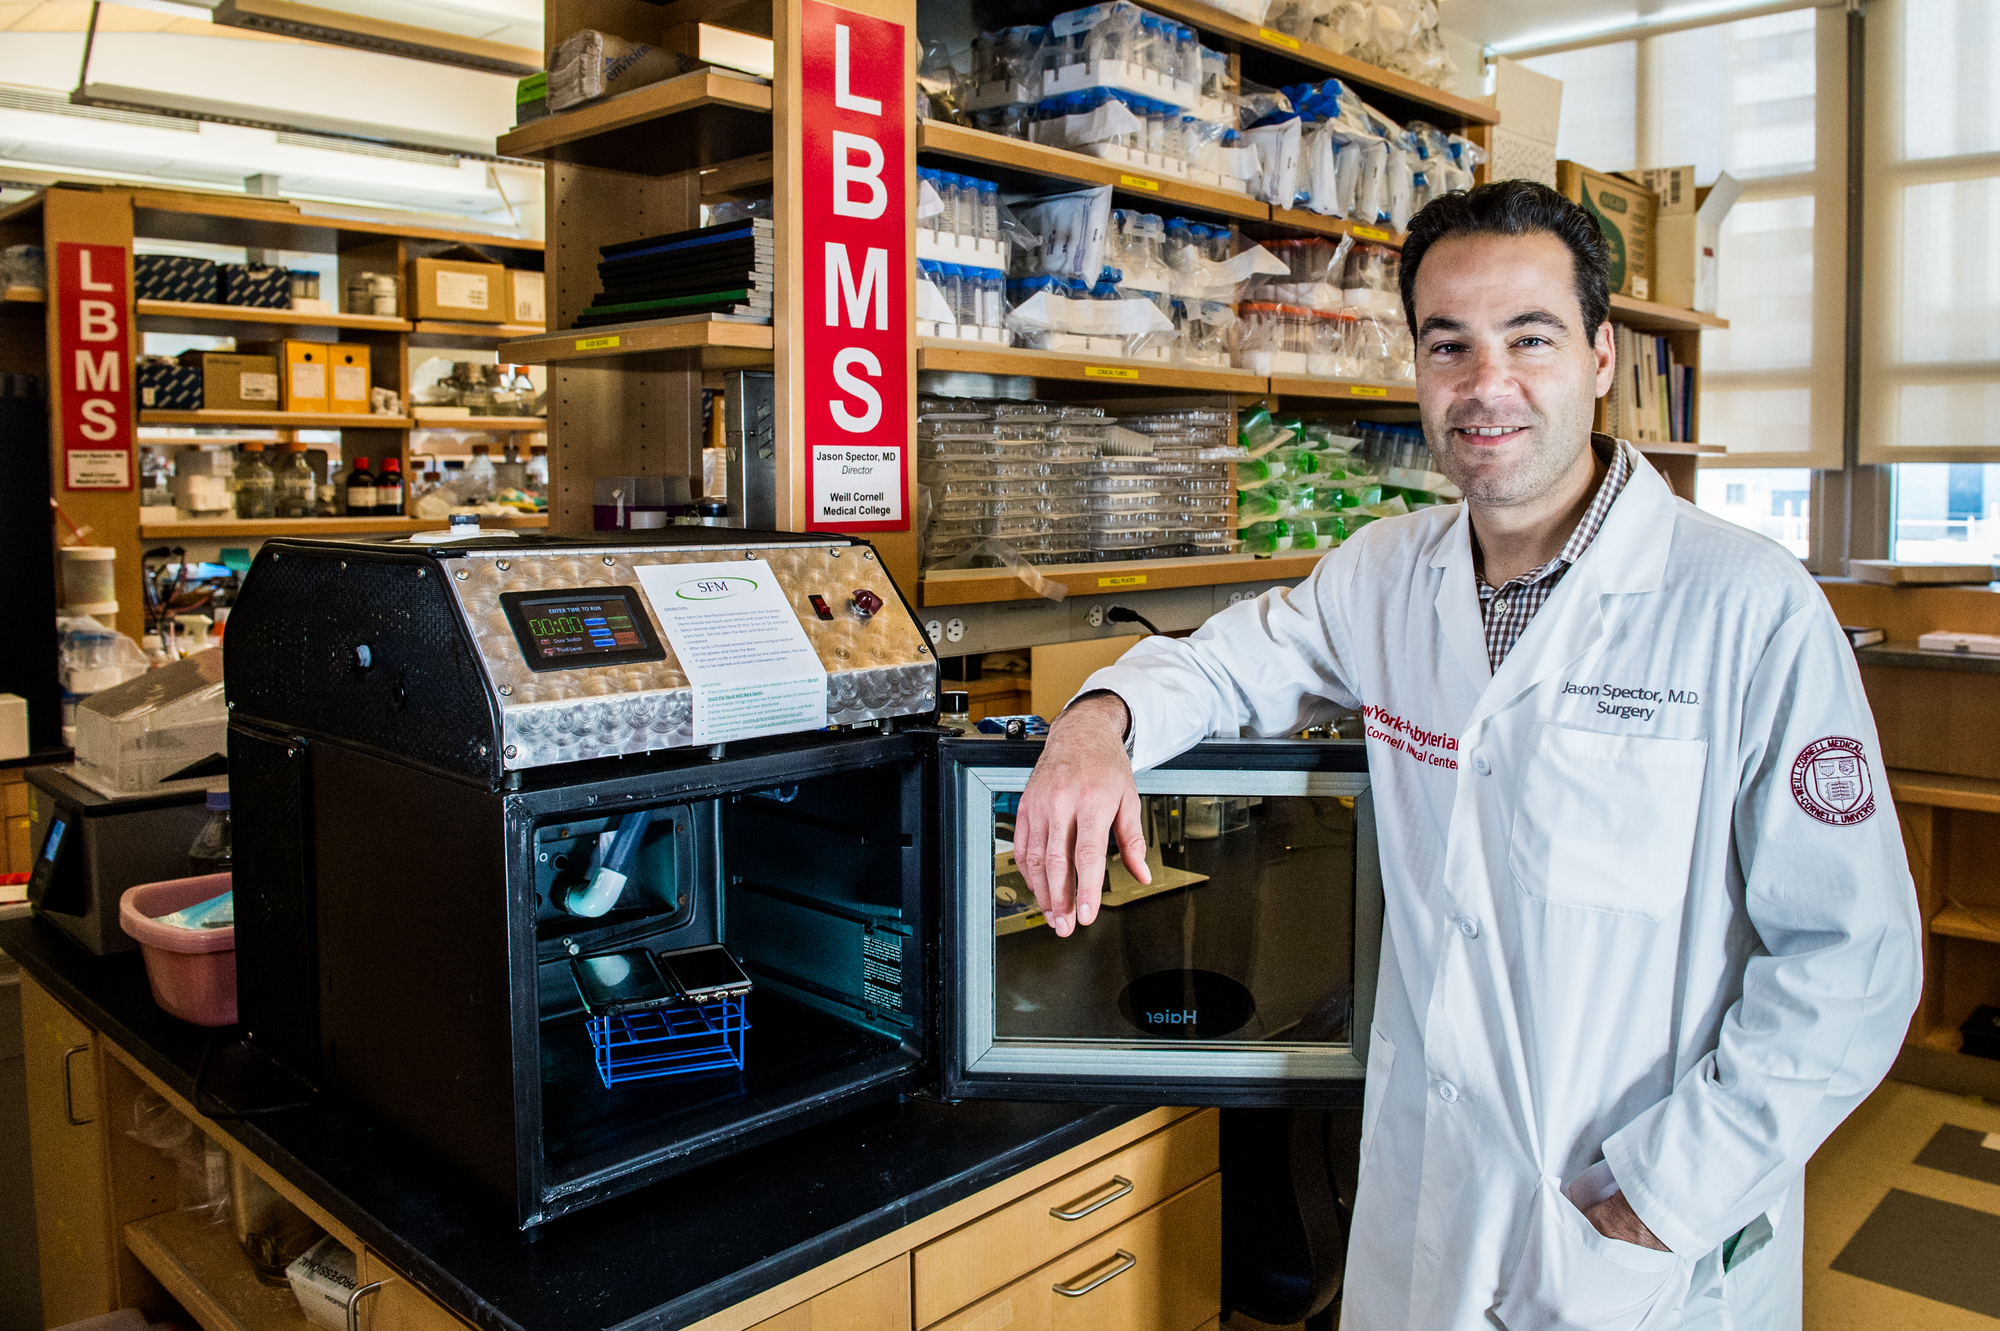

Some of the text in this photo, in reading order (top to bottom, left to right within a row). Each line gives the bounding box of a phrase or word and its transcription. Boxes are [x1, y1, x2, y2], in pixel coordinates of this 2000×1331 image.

[824, 24, 888, 433] LBMS
[74, 249, 121, 441] LBMS
[817, 452, 896, 463] Jason Spector, MD
[842, 465, 873, 474] Director
[830, 492, 884, 502] Weill Cornell
[824, 506, 890, 516] Medical College
[697, 581, 728, 592] SFM
[529, 617, 584, 636] 00:00
[1562, 682, 1699, 705] Jason Spector, M.D.
[1596, 701, 1654, 721] Surgery
[1367, 726, 1405, 750] Cornell
[1793, 740, 1864, 796] WEILL CORNELL MEDICAL
[1800, 798, 1838, 823] CORNELL
[298, 1258, 358, 1290] PROFESSIONAL
